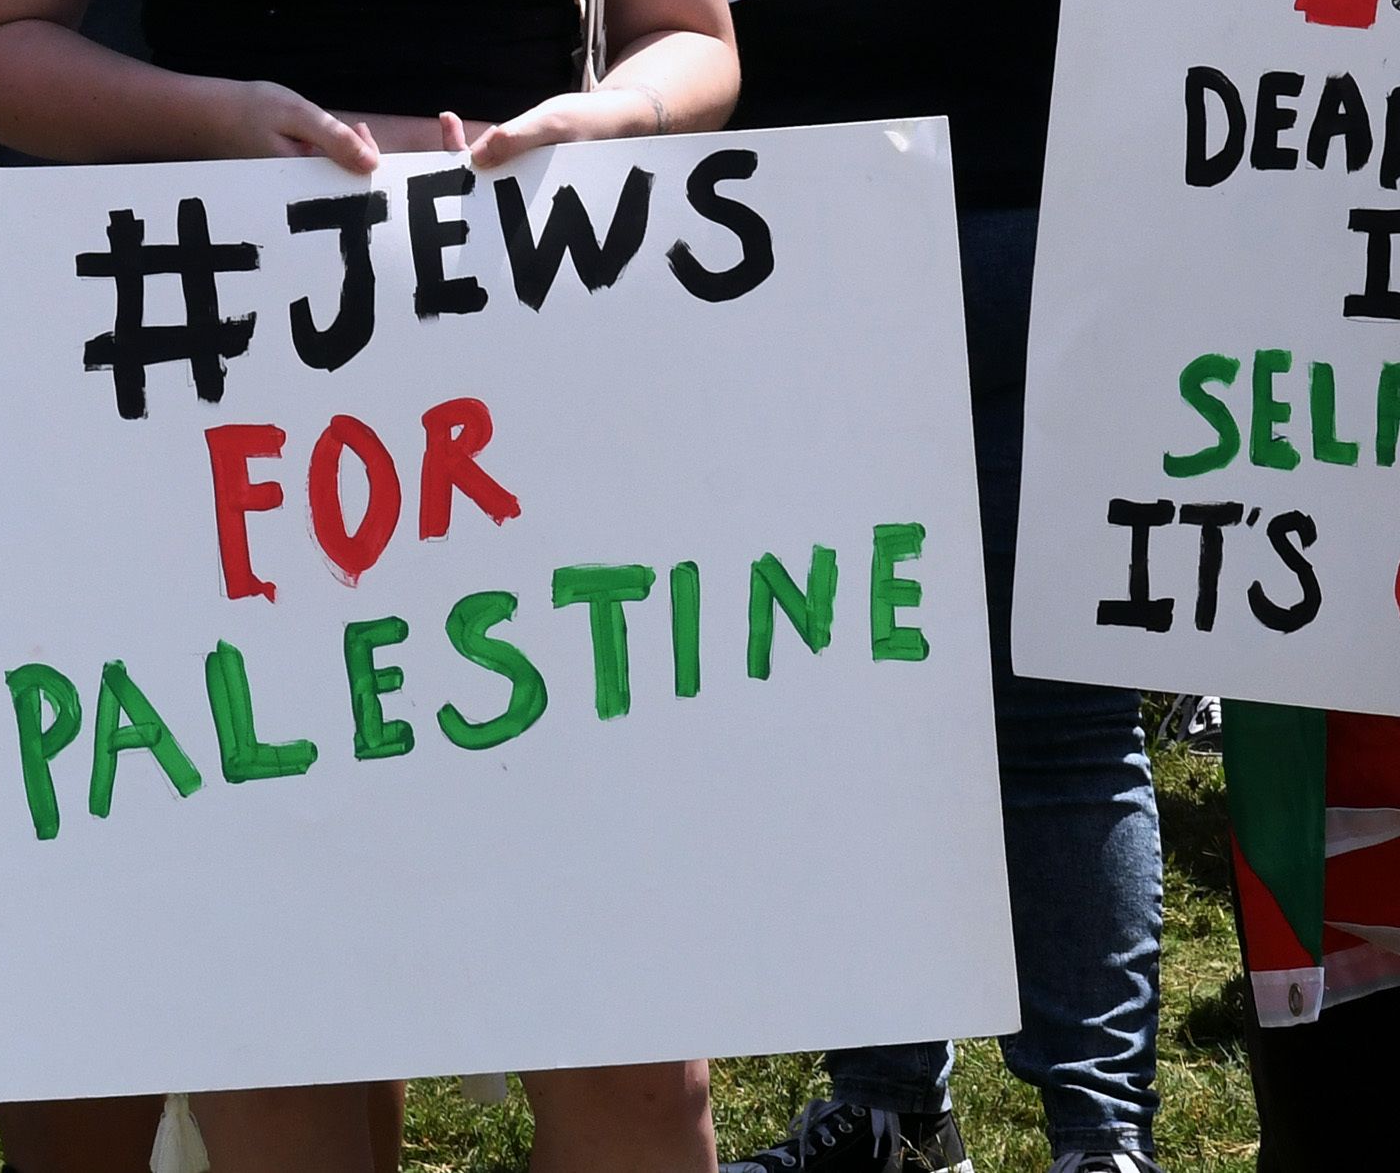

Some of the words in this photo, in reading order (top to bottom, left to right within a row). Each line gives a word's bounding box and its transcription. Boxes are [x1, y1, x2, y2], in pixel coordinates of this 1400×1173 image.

[75, 149, 775, 419] #JEWS
[204, 397, 521, 603] FOR
[1096, 498, 1323, 635] IT'S
[4, 522, 931, 840] PALESTINE
